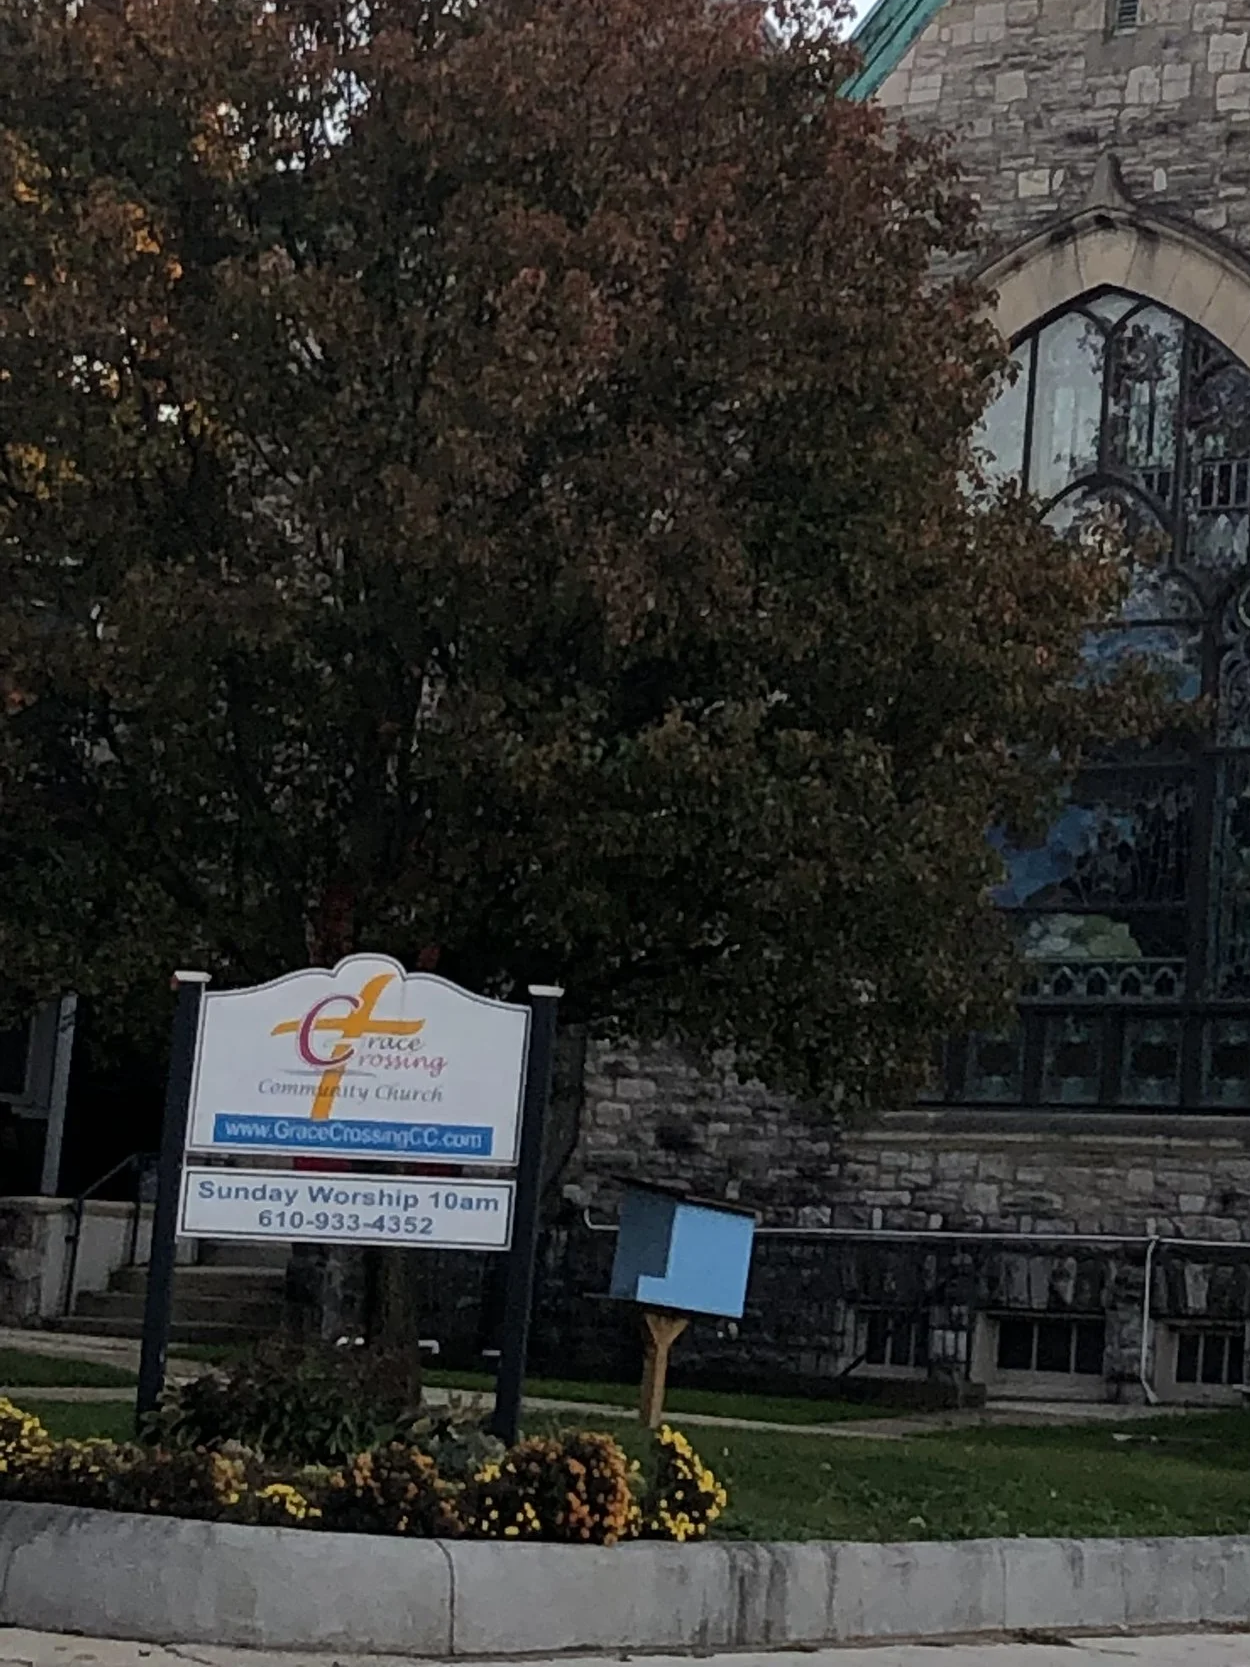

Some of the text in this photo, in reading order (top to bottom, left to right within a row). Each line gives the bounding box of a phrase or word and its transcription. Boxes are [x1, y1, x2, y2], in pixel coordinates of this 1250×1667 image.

[257, 1079, 443, 1104] Community Church
[225, 1120, 483, 1149] www.GraceCrossingCC.com
[198, 1180, 500, 1212] Sunday Worship 10am
[258, 1210, 434, 1235] 610-933-4352
